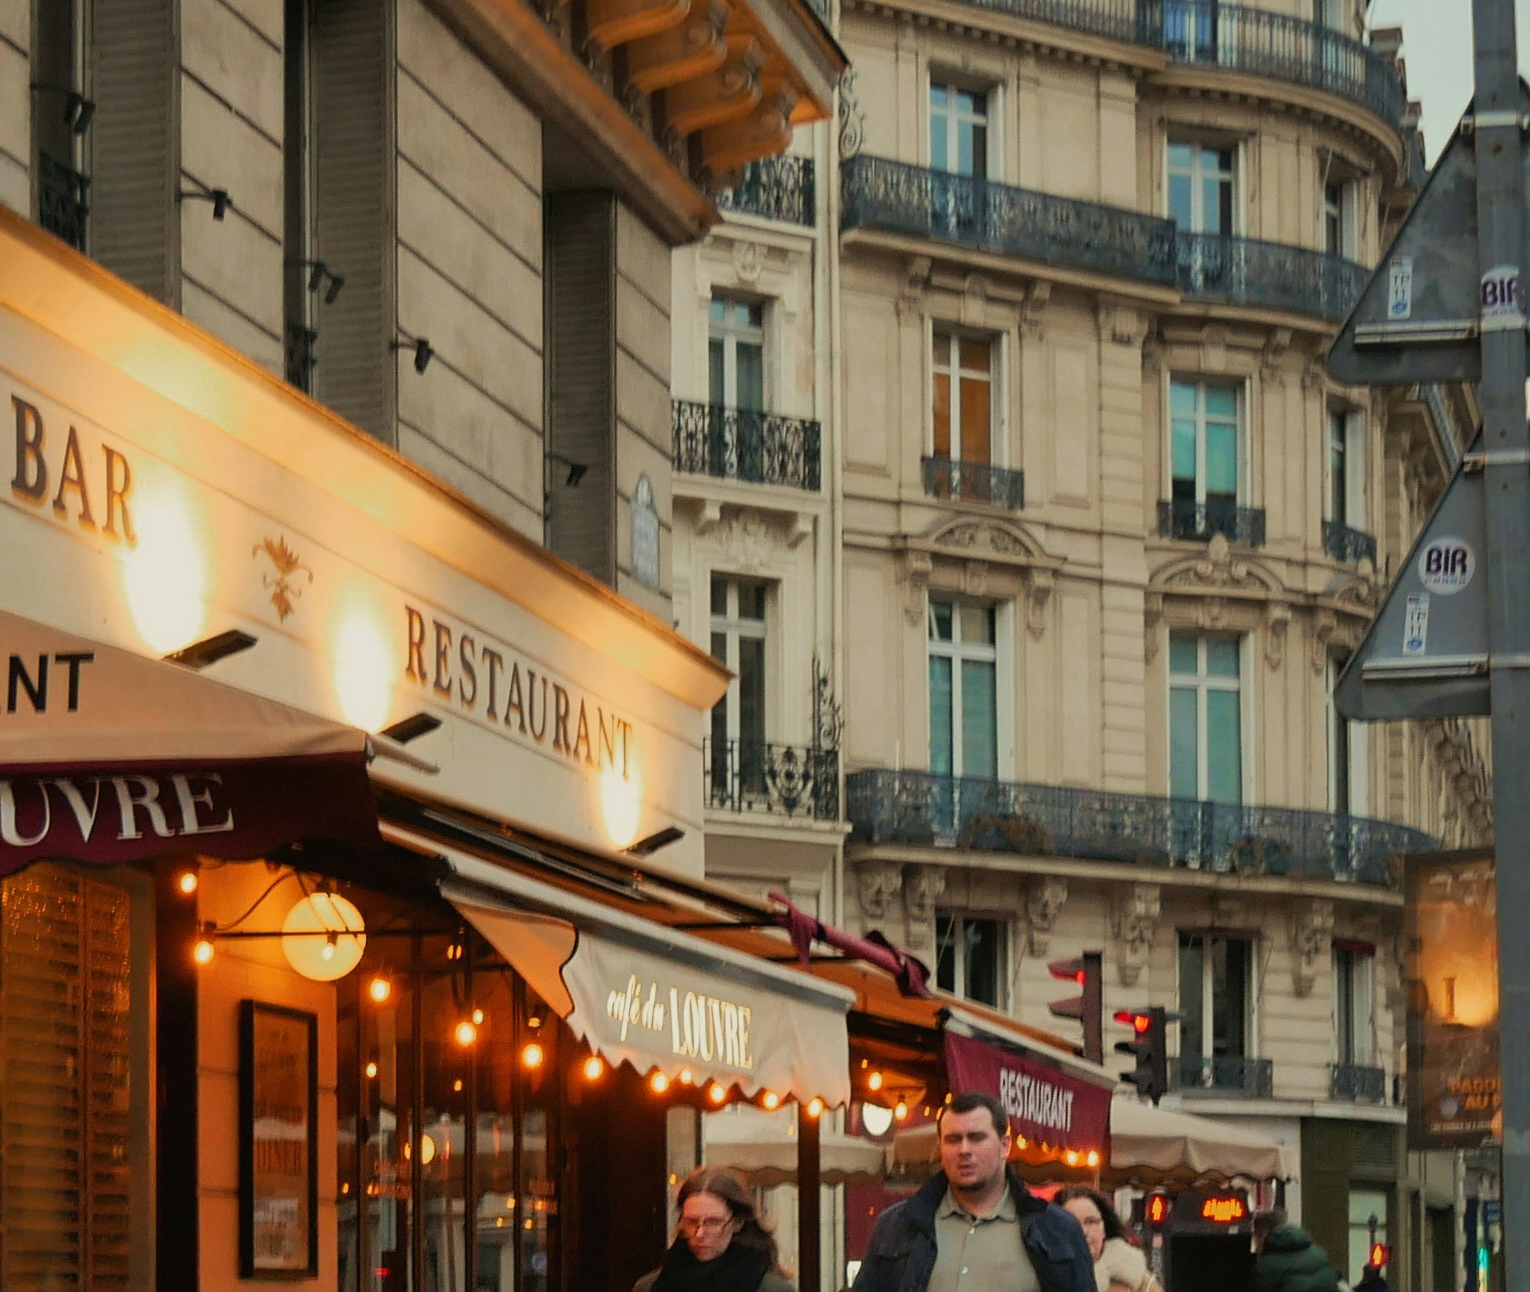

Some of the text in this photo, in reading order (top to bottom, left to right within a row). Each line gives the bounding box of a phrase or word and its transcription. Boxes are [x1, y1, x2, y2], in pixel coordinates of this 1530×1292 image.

[10, 392, 138, 548] BAR
[1426, 547, 1468, 576] BIR
[405, 604, 633, 782] RESTAURANT
[607, 974, 754, 1070] café du LOUVRE
[1000, 1066, 1074, 1133] RESTAURANT
